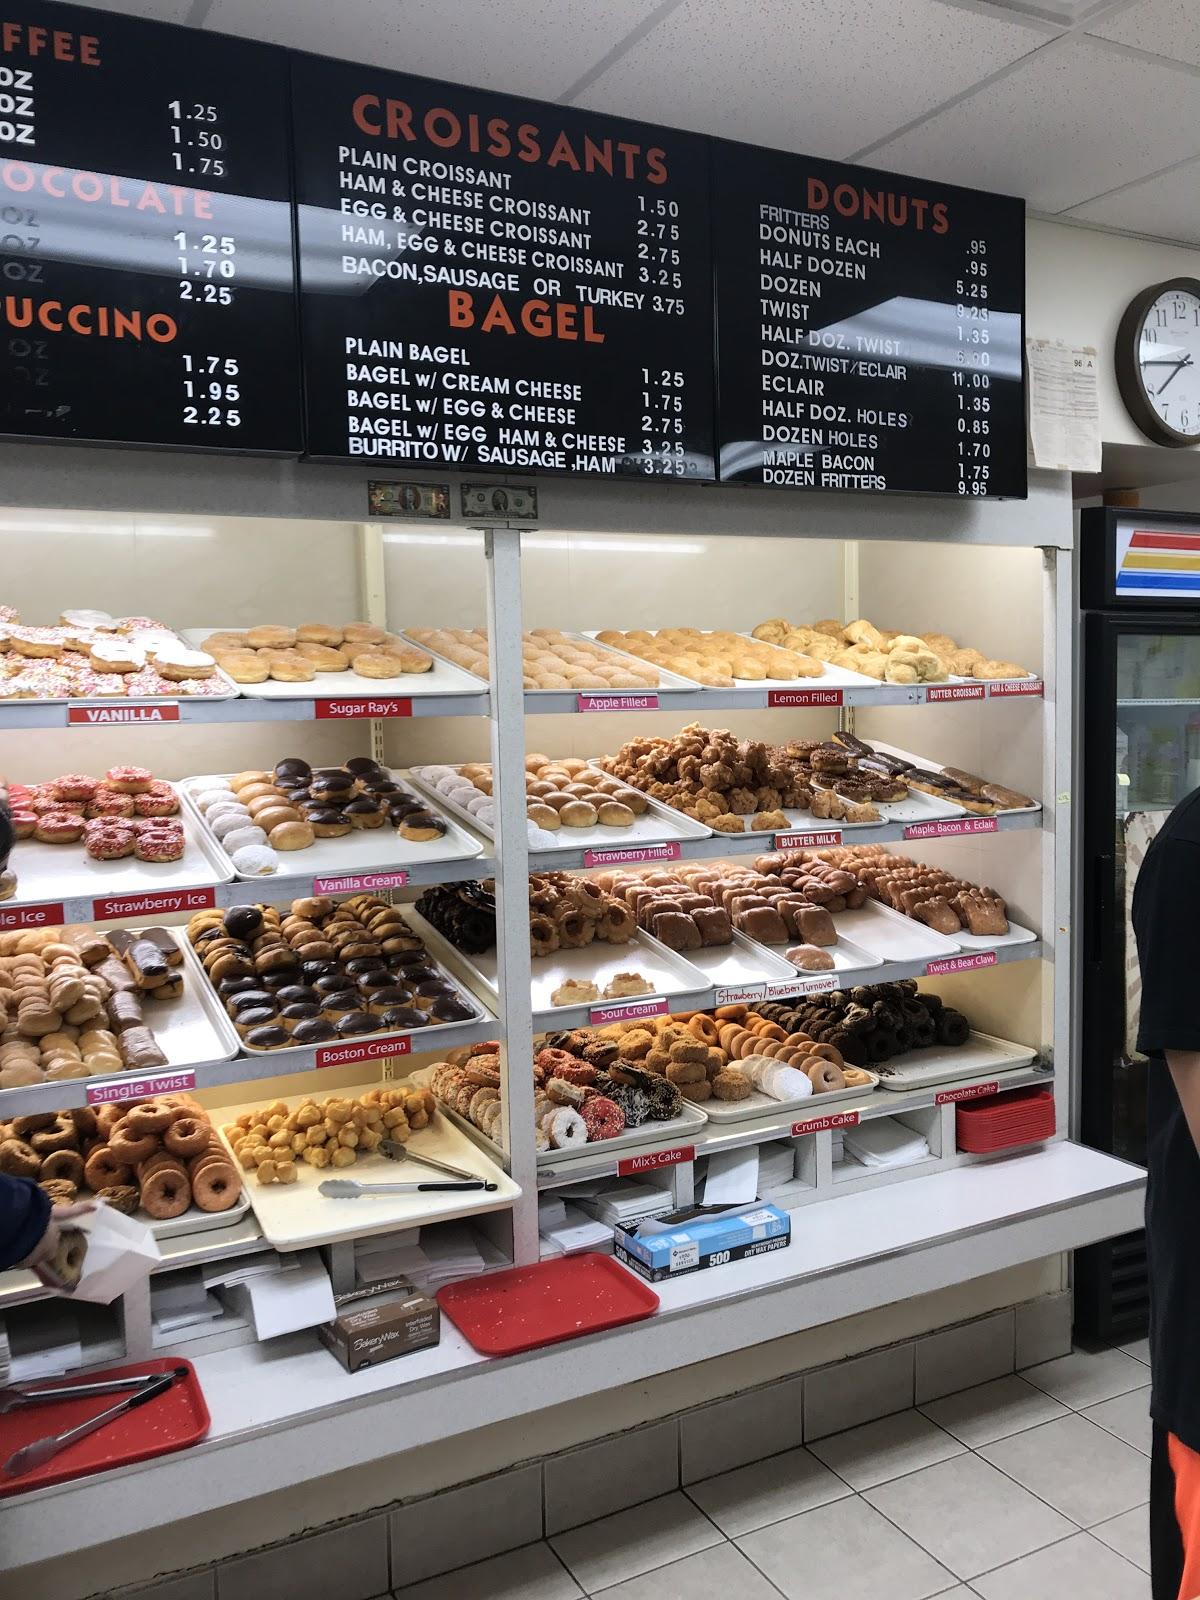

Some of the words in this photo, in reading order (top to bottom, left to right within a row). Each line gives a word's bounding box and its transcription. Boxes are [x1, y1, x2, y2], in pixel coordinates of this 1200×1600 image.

[0, 66, 34, 91] OZ
[168, 101, 217, 122] 1.25
[0, 93, 35, 117] OZ
[170, 126, 222, 150] 1.50
[0, 120, 36, 145] OZ
[172, 153, 225, 176] 1.75
[352, 94, 668, 184] CROISSANTS
[339, 146, 396, 172] PLAIN
[403, 157, 511, 190] CROISSANT
[638, 196, 679, 218] 1.50
[340, 171, 386, 195] HAM
[392, 180, 406, 197] &
[412, 183, 483, 210] CHEESE
[489, 195, 591, 226] CROISSANT
[637, 220, 680, 241] 2.75
[807, 177, 950, 235] DONUTS
[341, 198, 387, 220] EGG
[393, 206, 407, 223] &
[412, 209, 484, 235] CHEESE
[490, 220, 592, 250] CROISSANT
[638, 244, 680, 265] 2.75
[760, 204, 829, 230] FRITTERS
[966, 240, 987, 256] .95
[174, 232, 235, 256] 1.25
[760, 223, 830, 251] DONUTS
[835, 235, 880, 259] EACH
[965, 261, 987, 277] .95
[178, 256, 235, 278] 1.70
[342, 225, 392, 250] HAM,
[398, 232, 440, 253] EGG
[444, 239, 457, 256] &
[462, 241, 527, 266] CHEESE
[531, 251, 624, 279] CROISSANT
[639, 267, 682, 289] 3.25
[3, 262, 44, 283] OZ
[179, 281, 233, 305] 2.25
[342, 256, 520, 292] BACON,SAUSAGE
[533, 278, 561, 296] OR
[576, 285, 645, 310] TURKEY
[652, 296, 685, 316] 3.75
[760, 249, 802, 270] HALF
[807, 257, 866, 280] DOZEN
[956, 281, 988, 299] 5.25
[760, 274, 821, 298] DOZEN
[0, 296, 177, 343] UCCINO
[448, 289, 606, 344] BAGEL
[760, 299, 809, 321] TWIST
[957, 327, 989, 344] 1.35
[1156, 309, 1167, 327] 11
[1173, 302, 1186, 319] 12
[761, 324, 804, 344] HALF
[809, 329, 850, 350] DOZ.
[856, 336, 900, 356] TWIST
[182, 355, 239, 376] 1.75
[345, 337, 403, 360] PLAIN
[409, 343, 470, 366] BAGEL
[641, 368, 685, 388] 1.25
[183, 381, 240, 401] 1.95
[346, 363, 410, 387] BAGEL
[415, 370, 436, 390] w/
[442, 373, 510, 395] CREAM
[515, 380, 582, 402] CHEESE
[642, 392, 683, 412] 1.75
[952, 372, 989, 389] 11.00
[762, 375, 824, 396] ECLAIR
[958, 395, 990, 413] 1.35
[183, 407, 241, 427] 2.25
[347, 390, 411, 413] BAGEL
[415, 396, 438, 415] w/
[443, 398, 486, 419] EGG
[491, 403, 504, 420] &
[509, 404, 576, 426] CHEESE
[641, 416, 684, 434] 2.75
[762, 400, 804, 418] HALF
[810, 404, 851, 423] DOZ.
[857, 408, 908, 428] HOLES
[958, 418, 989, 435] 0.85
[1181, 410, 1189, 427] 6
[348, 416, 413, 440] BAGEL
[416, 422, 439, 441] w/
[444, 424, 487, 444] EGG
[499, 428, 540, 447] HAM
[545, 432, 558, 449] &
[562, 433, 626, 454] CHEESE
[642, 439, 685, 457] 3.25
[763, 424, 823, 445] DOZEN
[828, 430, 878, 449] HOLES
[958, 442, 990, 458] 1.70
[348, 436, 438, 460] BURRITO
[442, 444, 469, 463] W/
[478, 446, 567, 469] SAUSAGE
[644, 458, 685, 475] 3.25
[763, 450, 814, 469] MAPLE
[822, 454, 874, 472] BACON
[958, 463, 989, 480] 1.75
[763, 469, 815, 486] DOZEN
[821, 472, 887, 490] FRITTERS
[958, 481, 987, 496] 9.95
[589, 698, 619, 709] Apple
[621, 697, 648, 707] Filled
[773, 692, 803, 704] Lemon
[806, 691, 838, 702] Filled
[930, 688, 952, 699] BUTTER
[953, 687, 982, 697] CROISSANT
[86, 707, 163, 722] VANILLA
[329, 701, 366, 715] Sugar
[369, 700, 398, 714] Ray's
[909, 824, 935, 836] Maple
[937, 822, 961, 832] Bacon
[964, 822, 970, 830] &
[974, 819, 994, 829] Eclair
[781, 836, 815, 847] BUTTER
[817, 834, 837, 845] MILK
[592, 849, 646, 861] Strawberry
[319, 877, 360, 891] Vanilla
[362, 873, 403, 888] Cream
[104, 896, 182, 915] Strawberry
[187, 893, 207, 905] Ice
[21, 911, 46, 923] Ice
[929, 963, 949, 972] Twist
[950, 960, 957, 969] &
[957, 958, 974, 967] Bear
[975, 955, 994, 964] Claw
[800, 978, 837, 991] Turnover
[601, 1008, 624, 1020] Sour
[626, 1004, 658, 1016] Cream
[323, 1046, 365, 1062] Boston
[367, 1041, 406, 1056] Cream
[93, 1081, 145, 1101] Single
[149, 1075, 189, 1093] Twist
[937, 1088, 976, 1103] Chocolate
[977, 1084, 996, 1095] Cake
[795, 1118, 829, 1132] Crumb
[831, 1113, 855, 1125] Cake
[632, 1155, 656, 1168] Mix's
[658, 1151, 681, 1162] Cake
[709, 1250, 731, 1266] 500
[744, 1249, 755, 1257] DRY
[755, 1246, 767, 1254] WAX
[767, 1241, 786, 1252] PAPERS
[353, 1331, 400, 1351] BakeryWax
